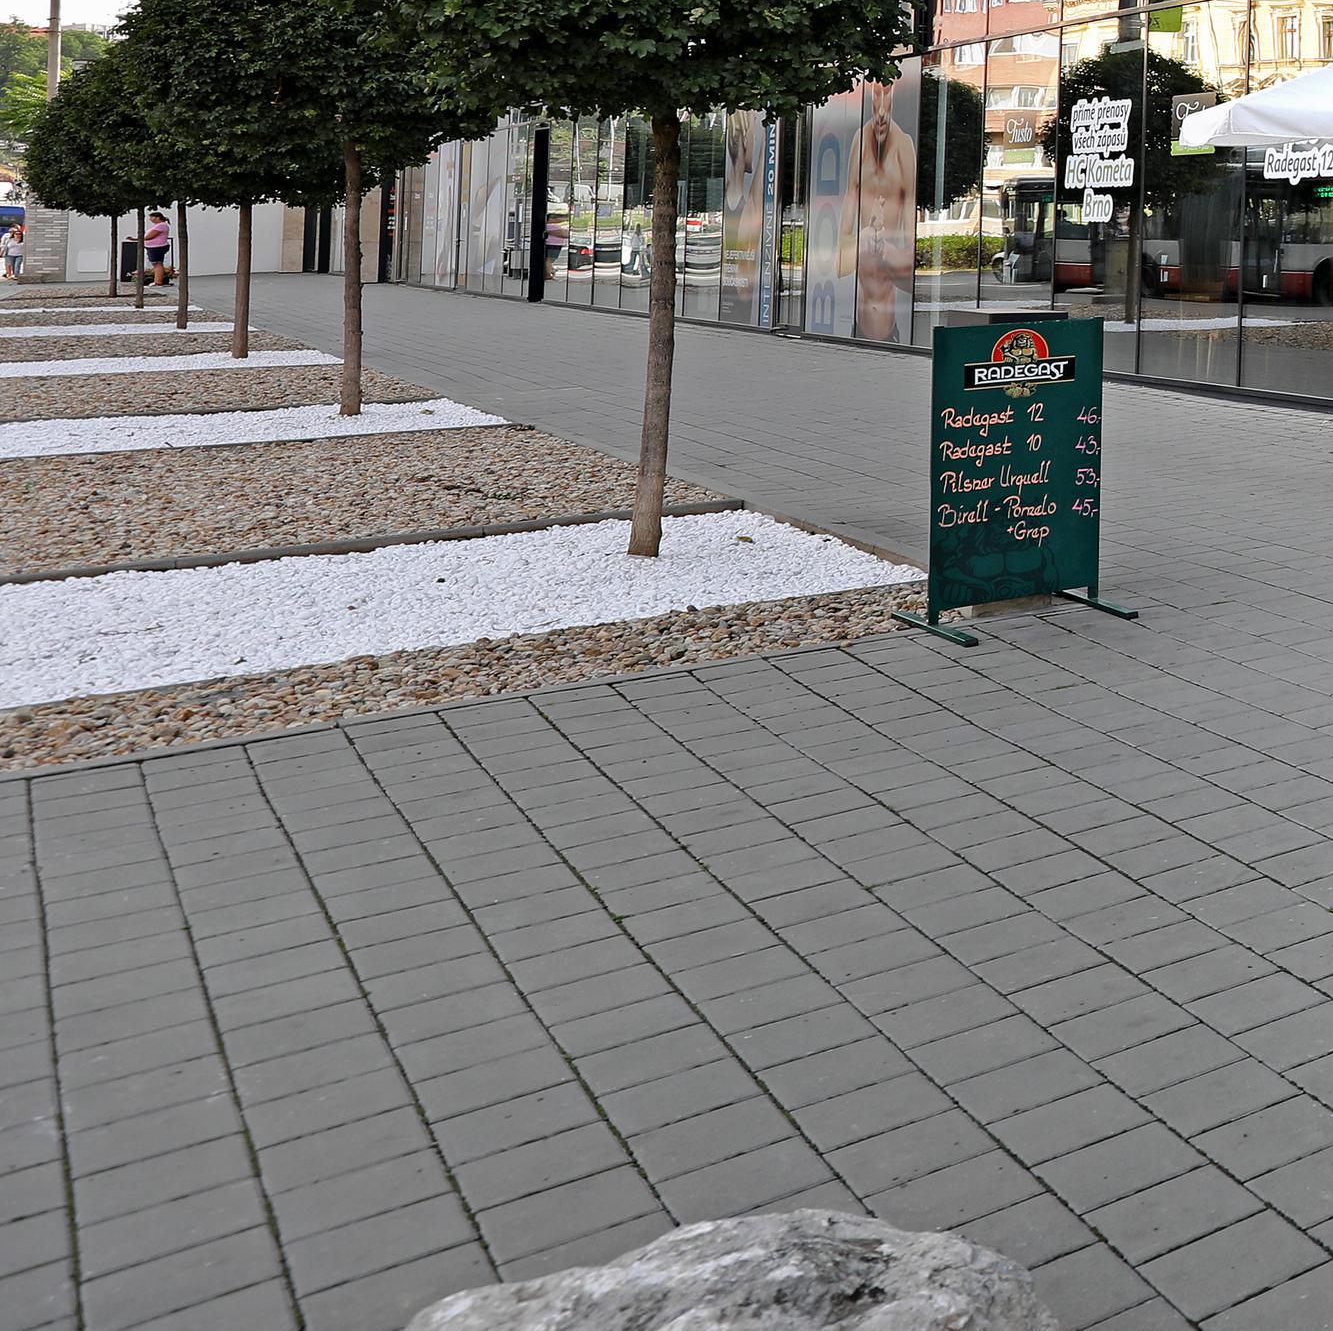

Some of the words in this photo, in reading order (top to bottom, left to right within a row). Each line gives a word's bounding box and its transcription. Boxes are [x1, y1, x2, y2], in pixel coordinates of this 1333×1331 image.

[1073, 101, 1096, 124] přímé
[1097, 100, 1130, 126] přenosy
[1006, 117, 1033, 143] Tusto
[1074, 130, 1095, 150] všech
[1097, 126, 1126, 152] zápasů
[1066, 158, 1086, 185] HC
[1086, 157, 1133, 184] Kometa
[1266, 150, 1318, 179] Radegast
[1084, 192, 1112, 218] Brno
[973, 360, 1069, 386] RADEGAST
[939, 404, 1014, 437] Radegast
[1027, 402, 1045, 423] 12
[939, 434, 1013, 467] Radegast
[1026, 433, 1042, 452] 10
[939, 470, 995, 495] Pilsner
[1000, 460, 1051, 495] Urquell
[937, 499, 989, 528] Birell
[1002, 493, 1057, 519] Pomelo
